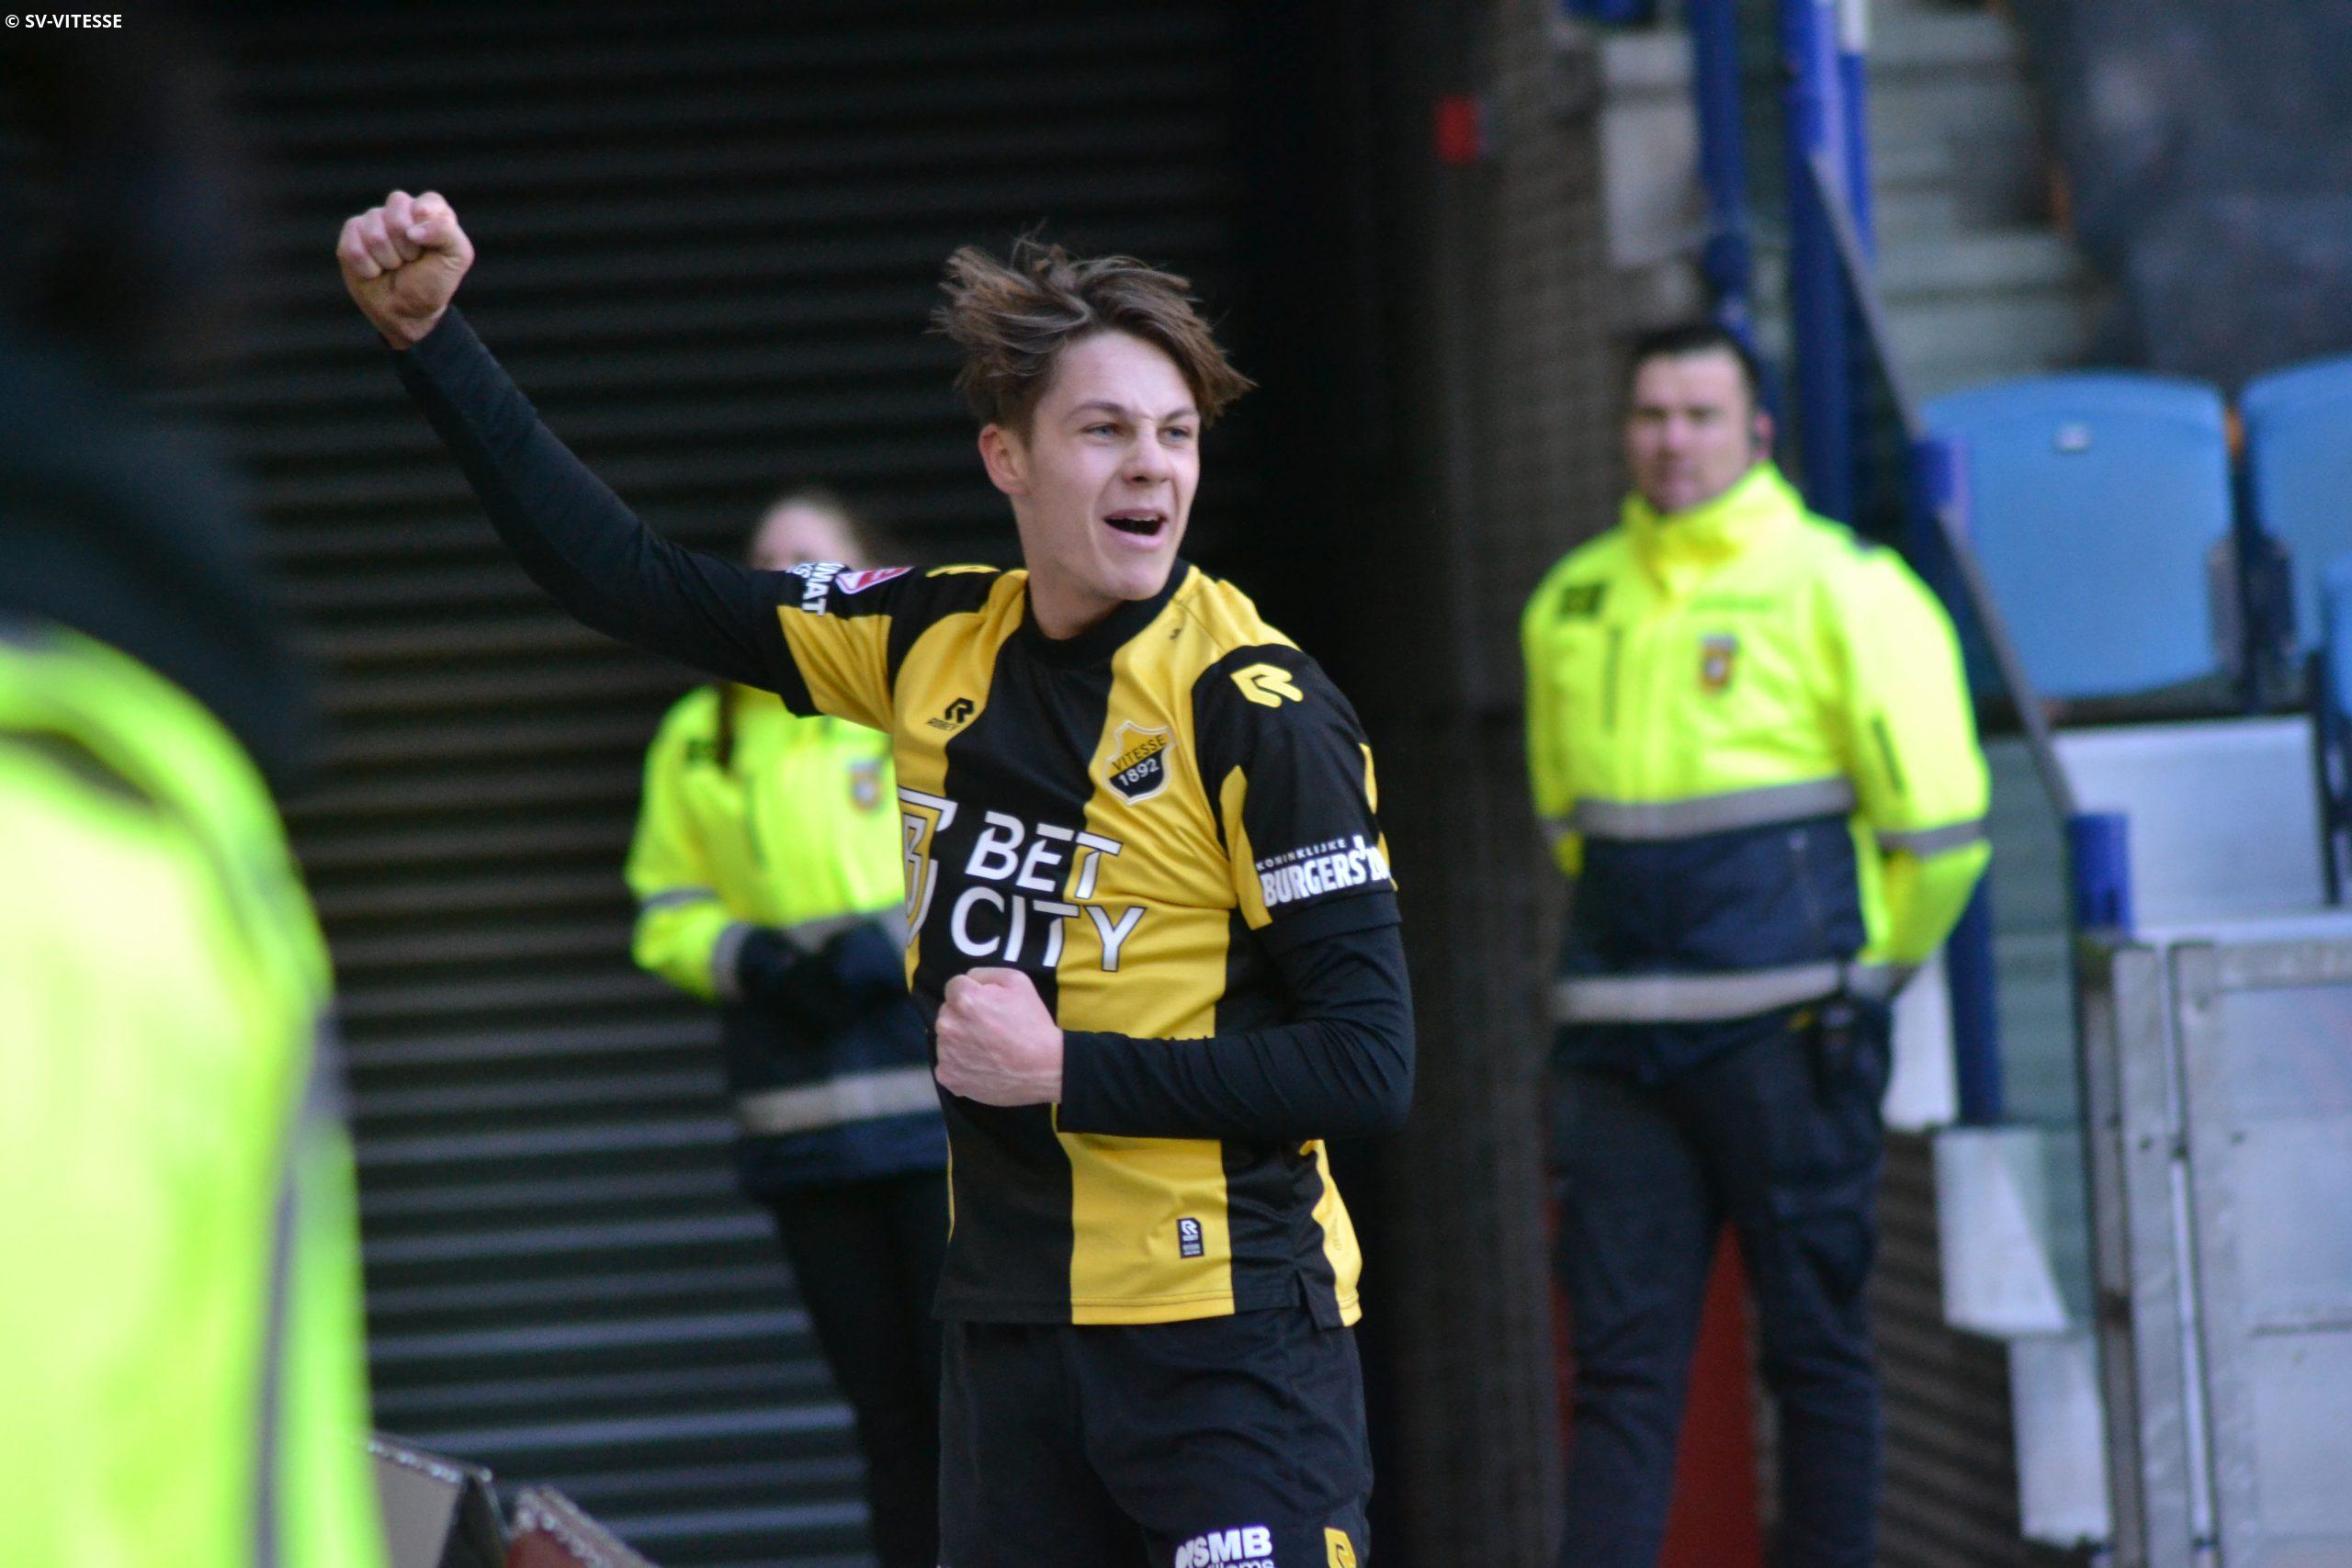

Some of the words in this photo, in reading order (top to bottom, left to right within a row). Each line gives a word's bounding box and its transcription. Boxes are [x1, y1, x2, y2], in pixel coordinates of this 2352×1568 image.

[1112, 735, 1167, 771] VITESSE
[1118, 758, 1159, 786] 1892
[965, 809, 1124, 899] BET
[1256, 838, 1347, 871] KONINKLIJKE
[951, 886, 1148, 973] CITY
